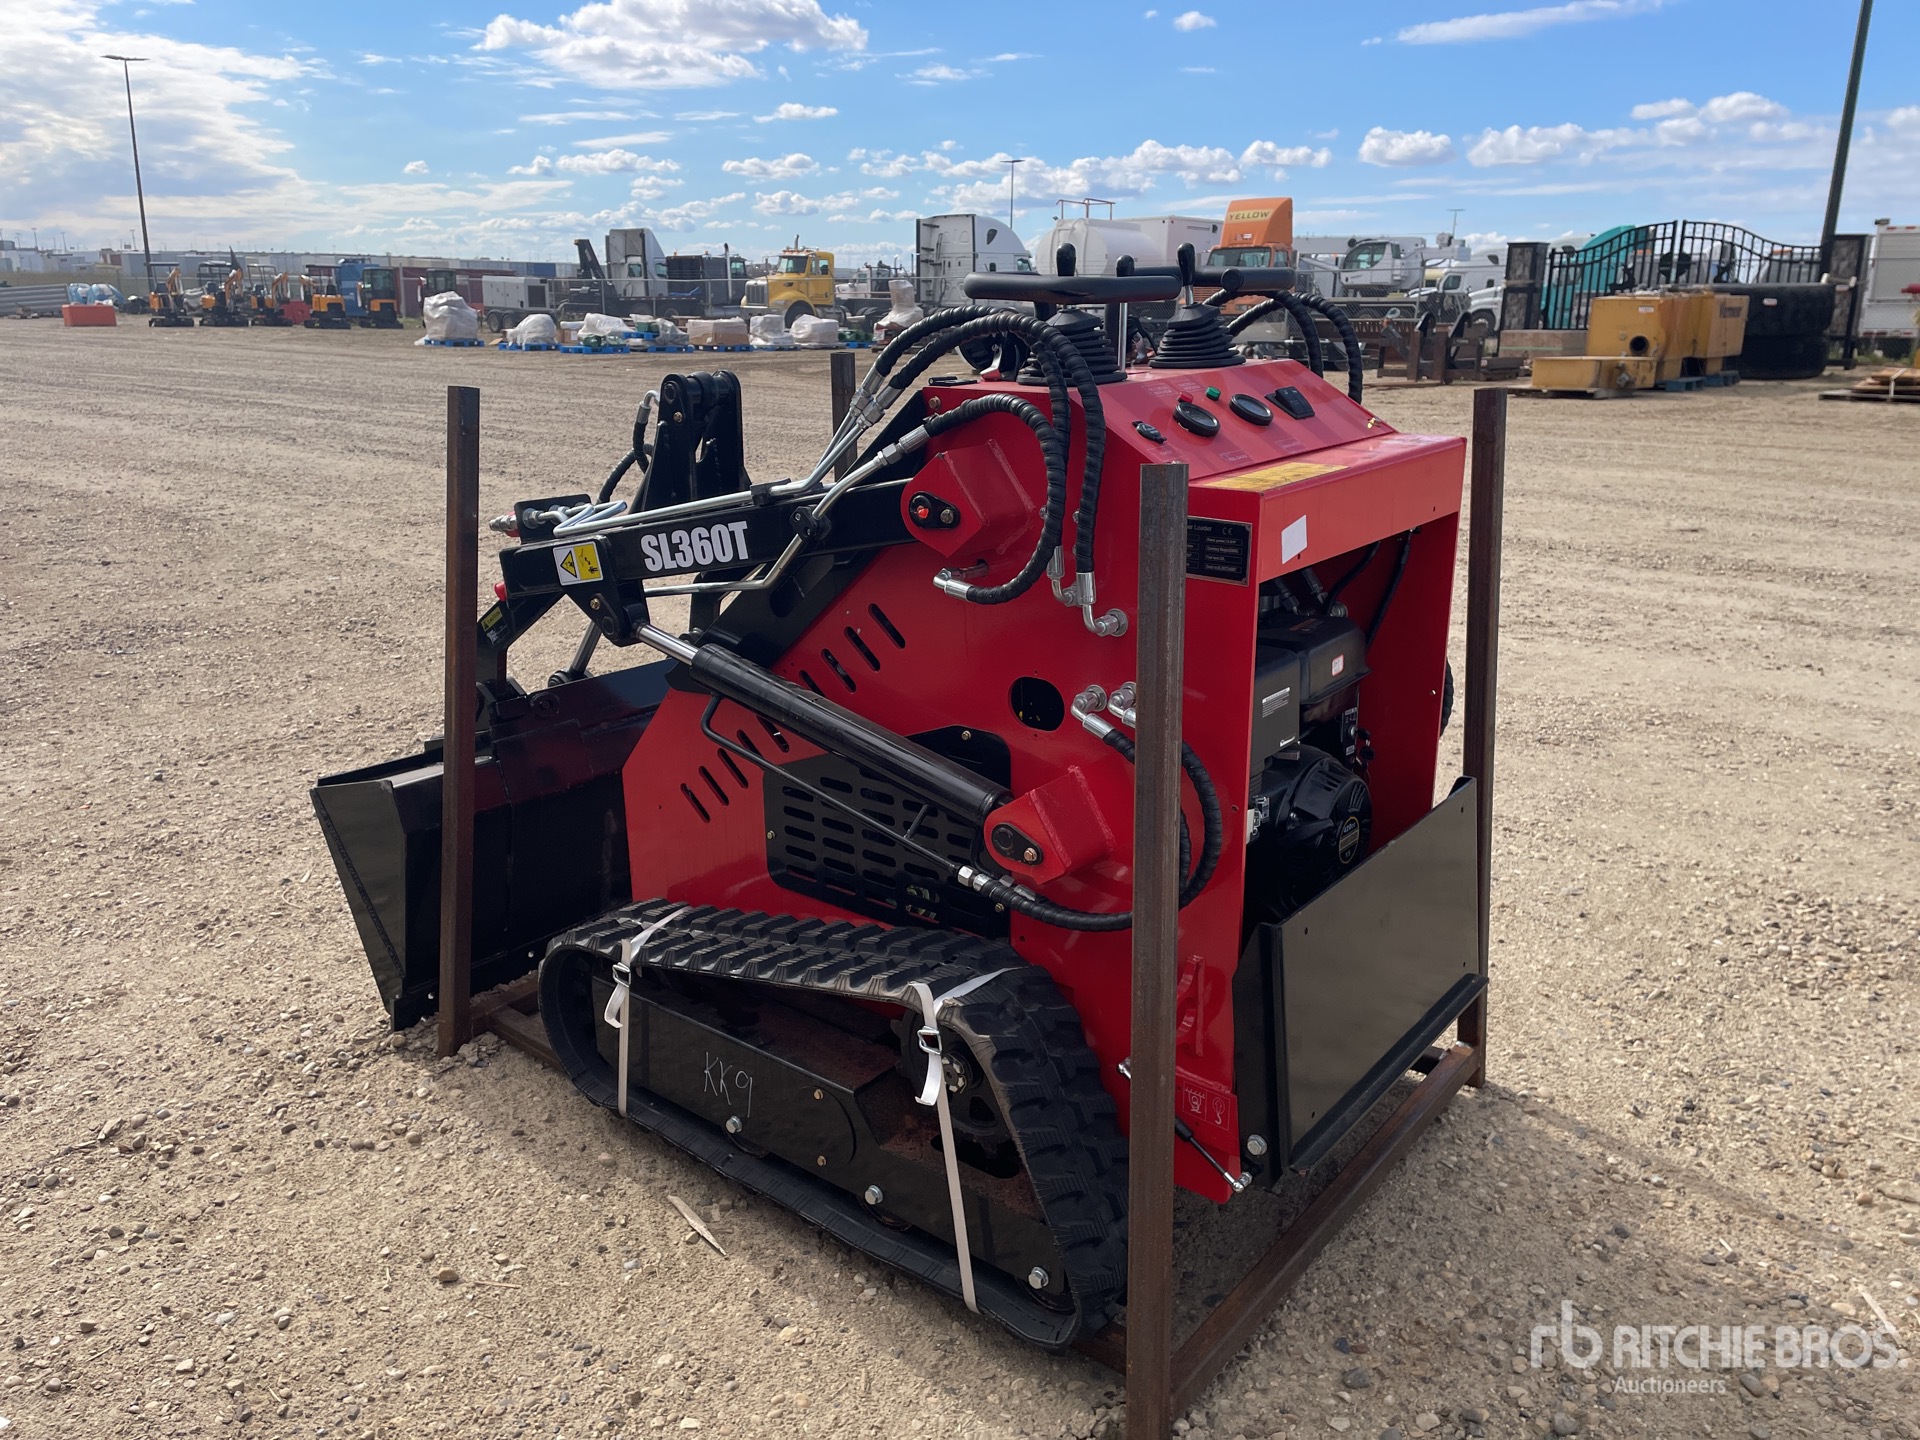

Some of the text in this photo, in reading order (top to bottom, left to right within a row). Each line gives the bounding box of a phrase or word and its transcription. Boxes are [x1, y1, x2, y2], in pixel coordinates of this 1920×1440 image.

[1229, 211, 1270, 220] YELLOW
[641, 521, 749, 572] SL360T
[704, 1052, 753, 1118] KK9
